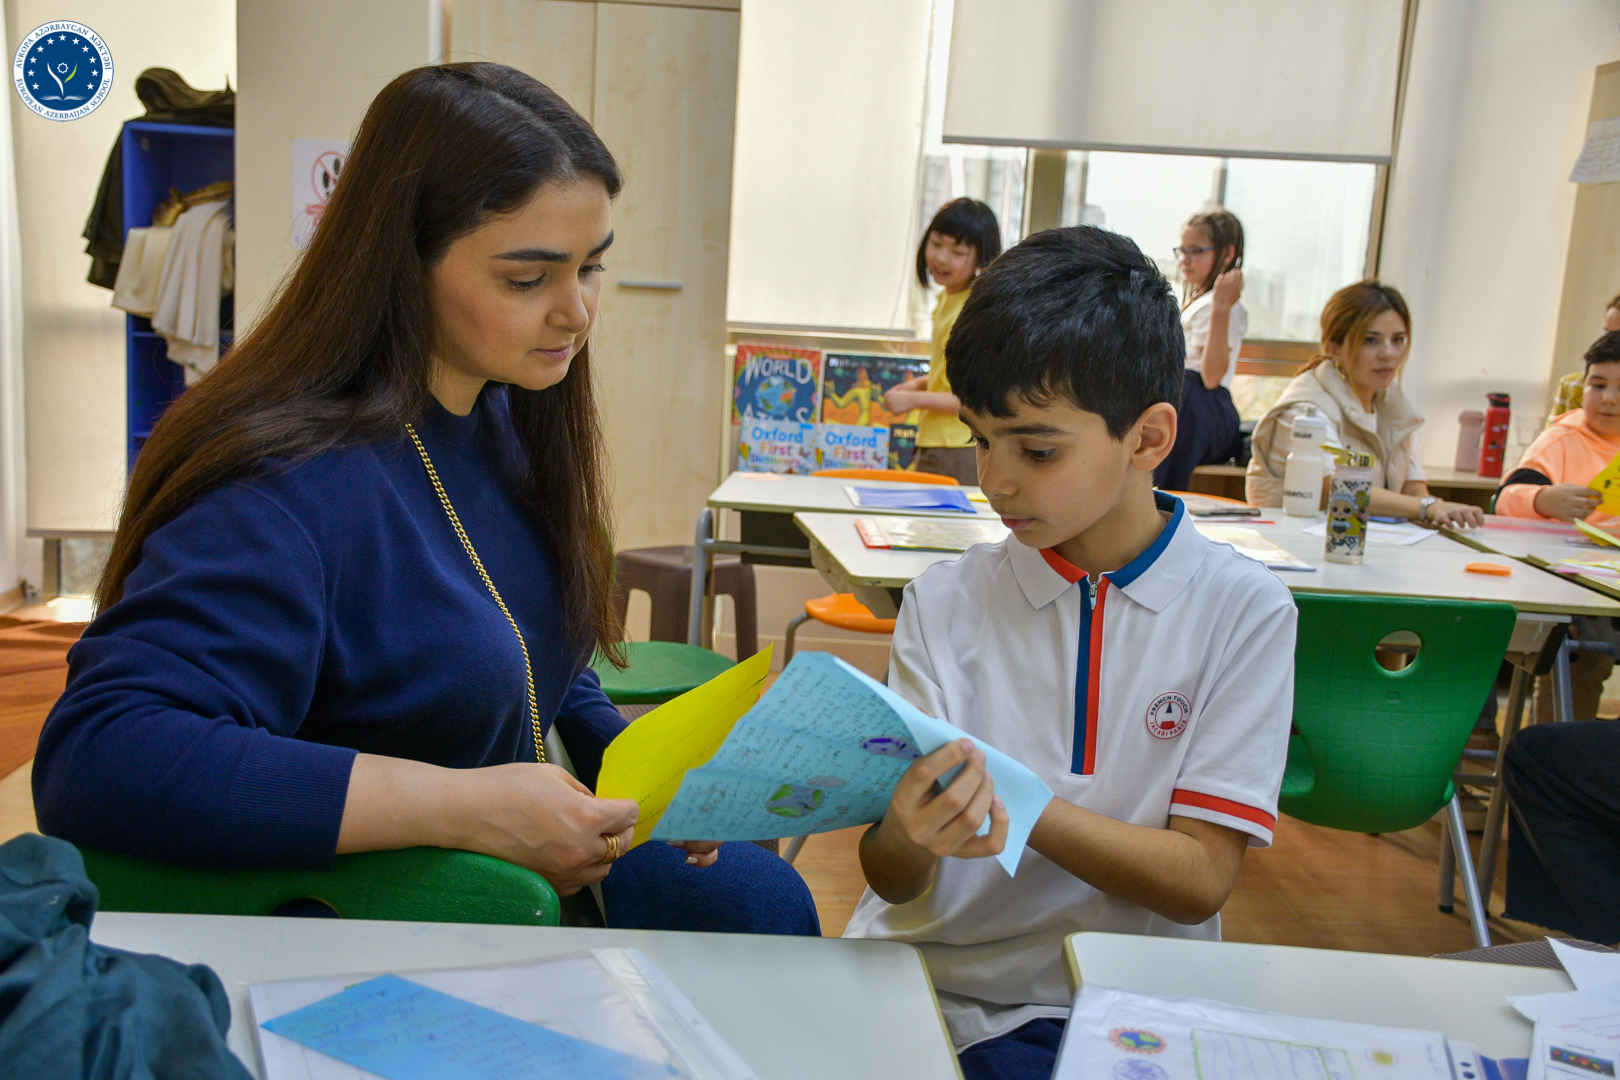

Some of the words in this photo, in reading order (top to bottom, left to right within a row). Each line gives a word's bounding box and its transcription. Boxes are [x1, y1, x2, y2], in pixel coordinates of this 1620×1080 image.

[745, 352, 812, 387] WORLD
[752, 427, 803, 443] Oxford
[826, 431, 877, 448] Oxford
[761, 442, 792, 456] First
[835, 446, 865, 460] First
[1150, 695, 1172, 715] FRENCH
[1173, 695, 1189, 713] TOUCH
[1149, 721, 1168, 736] JACADI
[1169, 719, 1187, 736] PARIS
